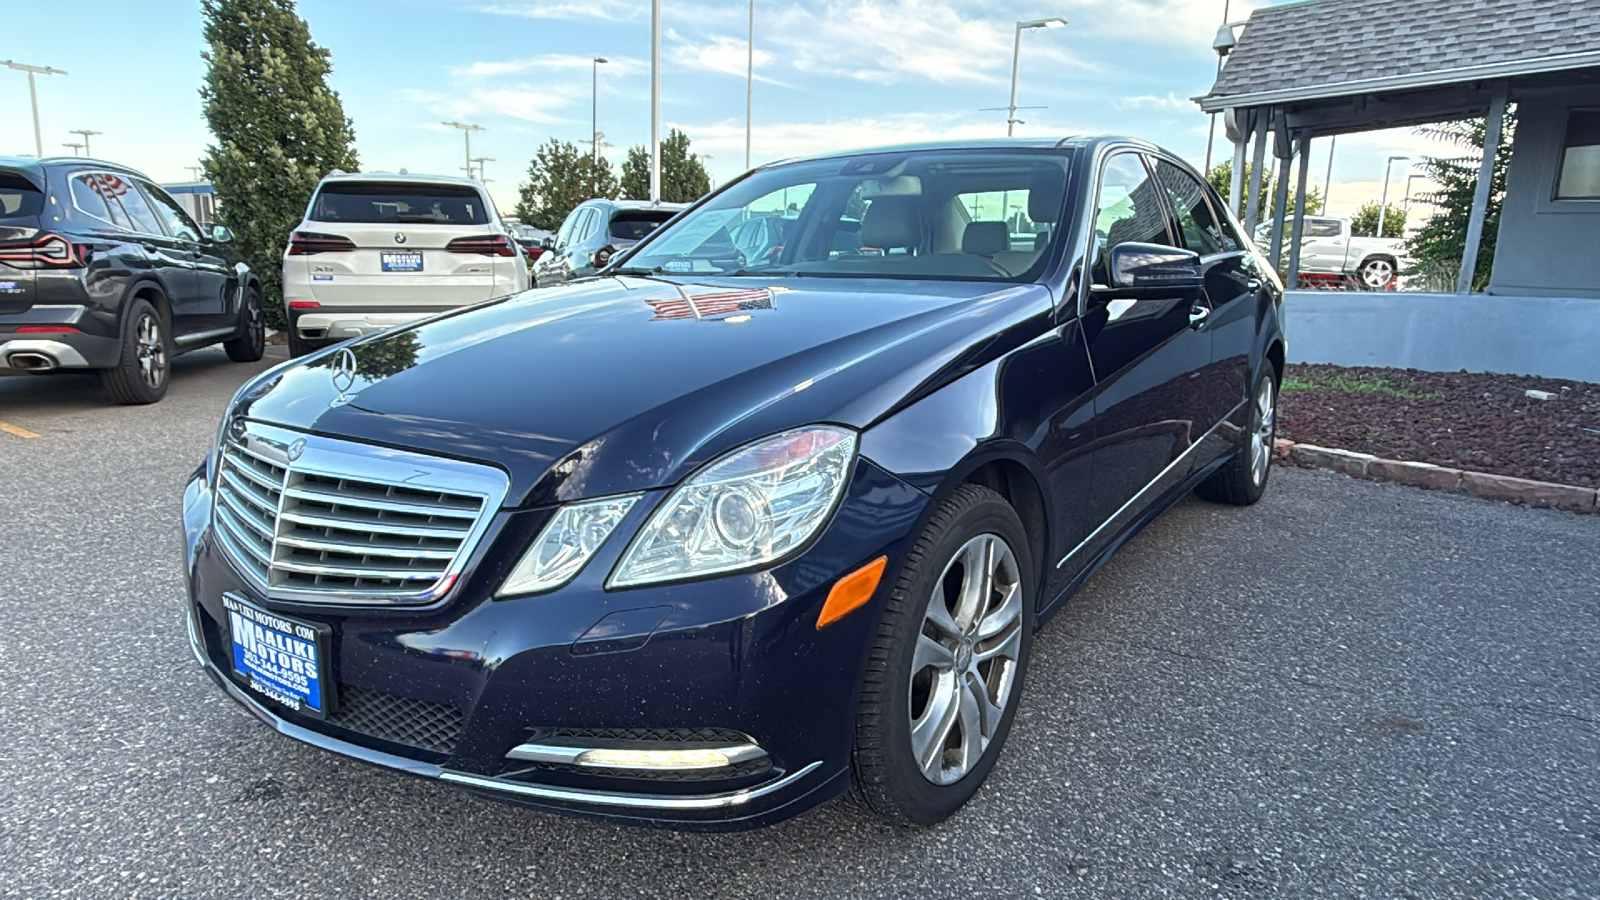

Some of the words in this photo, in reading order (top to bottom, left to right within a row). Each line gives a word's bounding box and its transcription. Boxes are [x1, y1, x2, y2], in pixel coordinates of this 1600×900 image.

[231, 611, 315, 660] MAALIKI
[254, 611, 292, 634] MOTORS
[243, 648, 308, 686] 303-344-9595
